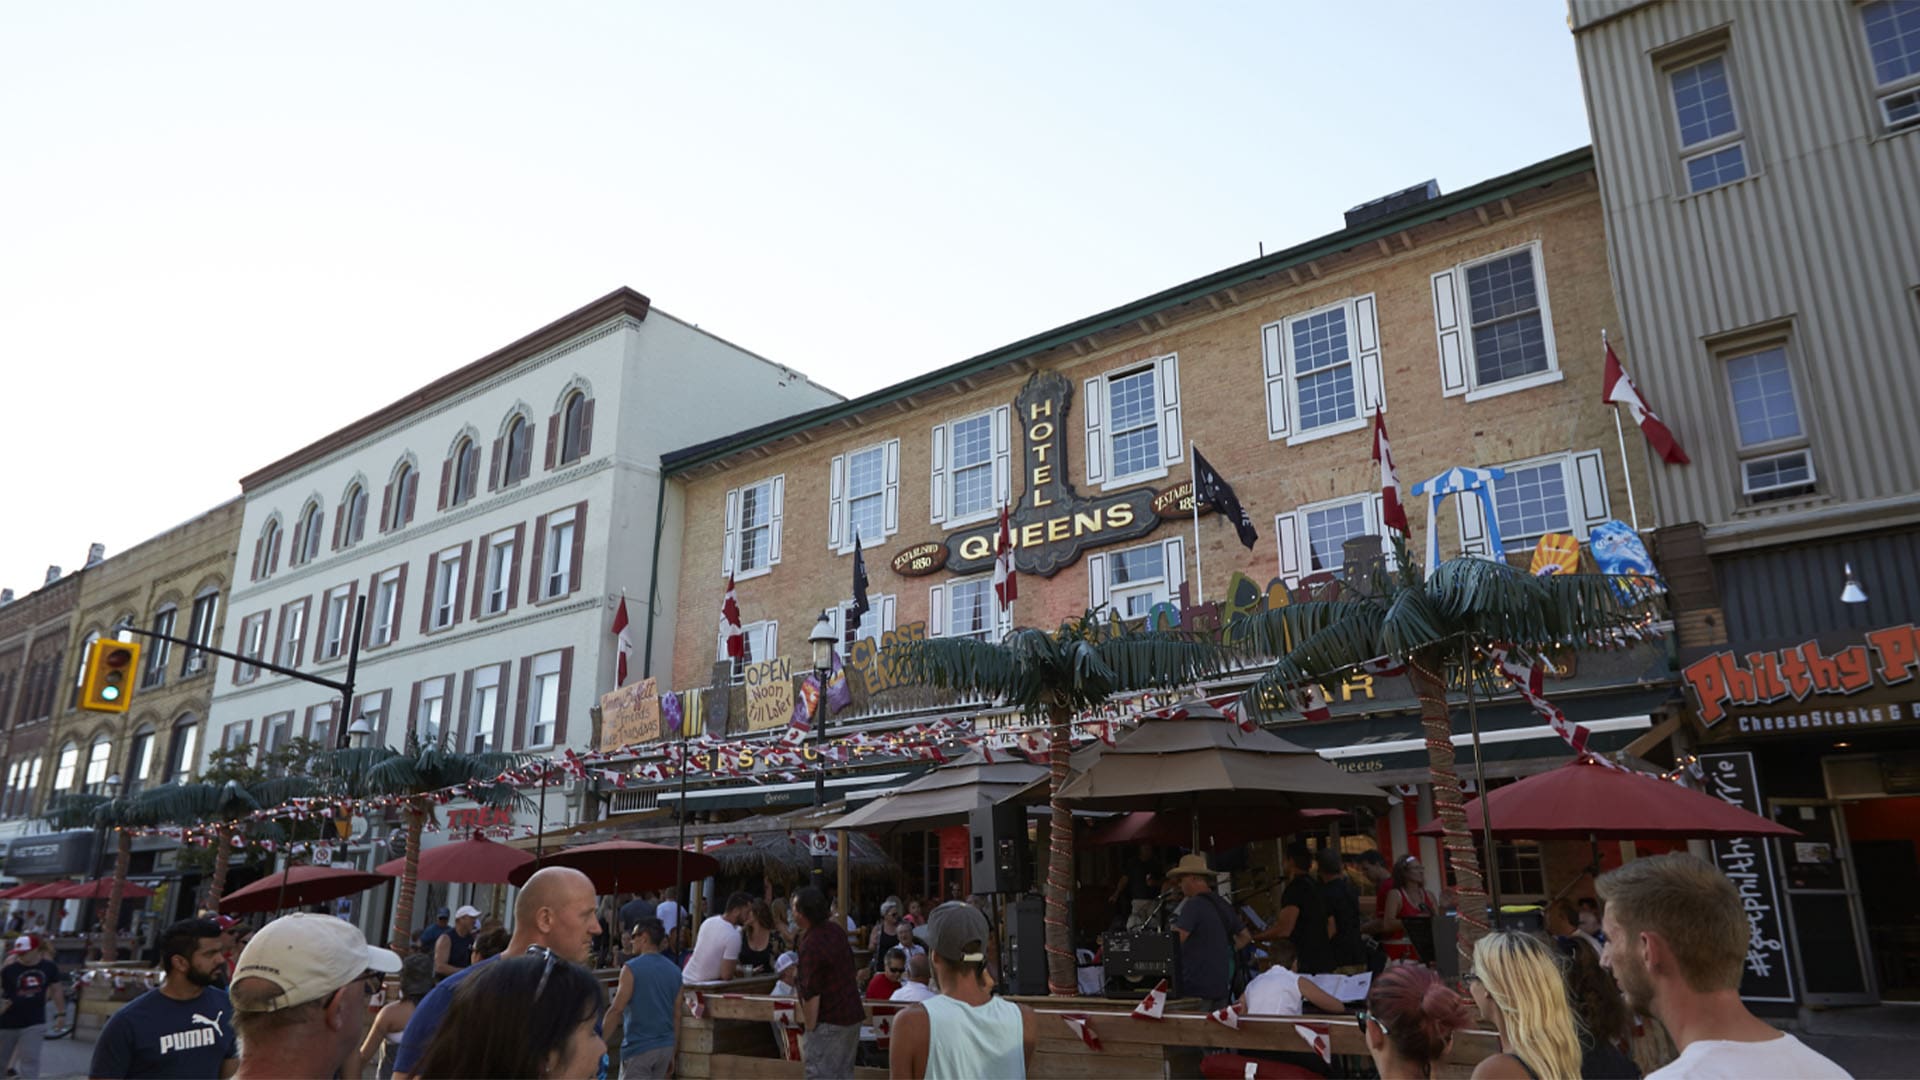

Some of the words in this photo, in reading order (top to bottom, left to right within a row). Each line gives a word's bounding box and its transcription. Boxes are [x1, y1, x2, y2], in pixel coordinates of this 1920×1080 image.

[1029, 401, 1052, 507] HOTEL
[1154, 482, 1193, 512] ESTABLI
[959, 502, 1134, 561] QUEENS
[747, 657, 791, 686] OPEN
[1682, 639, 1874, 728] Philthy
[1865, 623, 1920, 686] P
[751, 685, 784, 703] Noon
[1738, 707, 1883, 733] CheeseSteaks
[1331, 759, 1384, 773] ueens
[447, 804, 514, 829] TREK
[160, 1027, 215, 1054] PUMA
